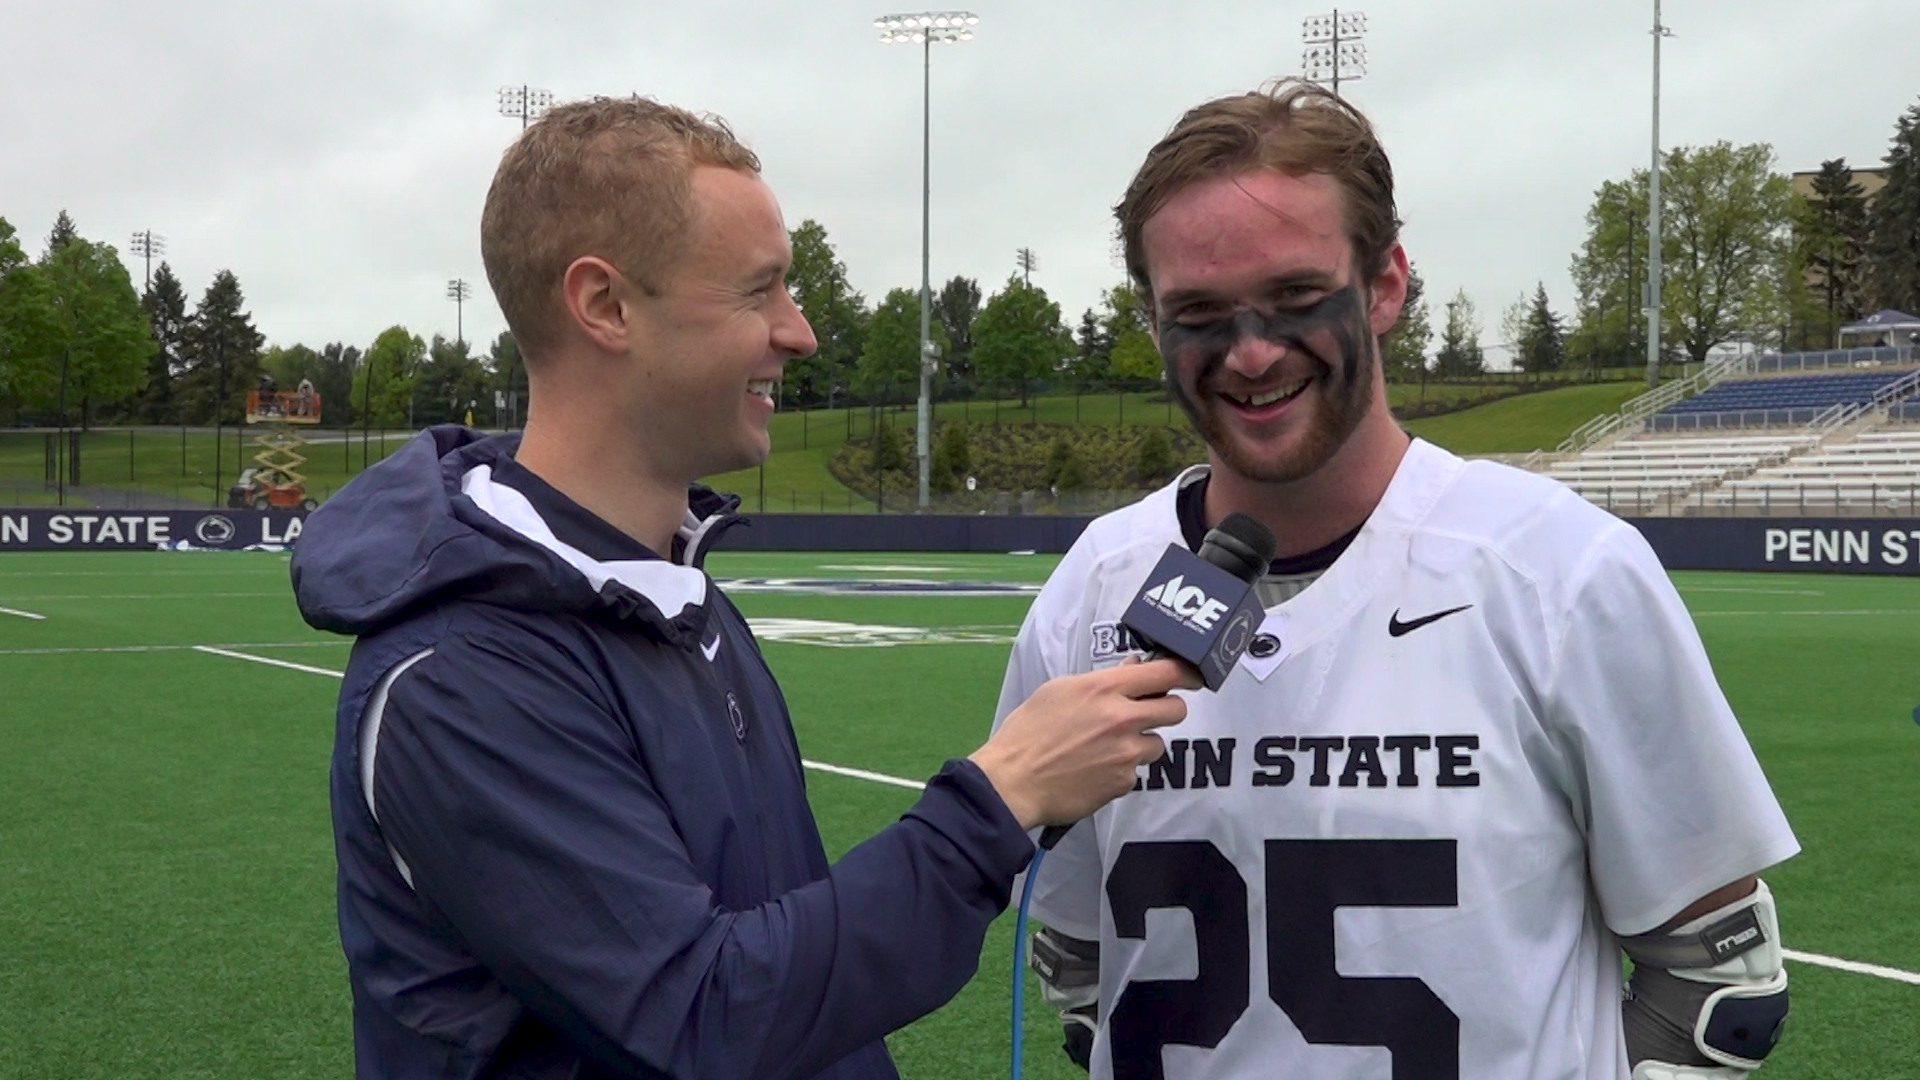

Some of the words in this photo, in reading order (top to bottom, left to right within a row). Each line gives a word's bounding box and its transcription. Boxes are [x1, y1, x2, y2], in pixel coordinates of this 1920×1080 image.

[2, 515, 29, 543] N
[48, 515, 171, 543] STATE
[1765, 529, 1870, 564] PENN
[1144, 574, 1230, 630] ACE
[1132, 737, 1237, 791] NN
[1252, 735, 1480, 788] STATE
[1105, 839, 1461, 1080] 25
